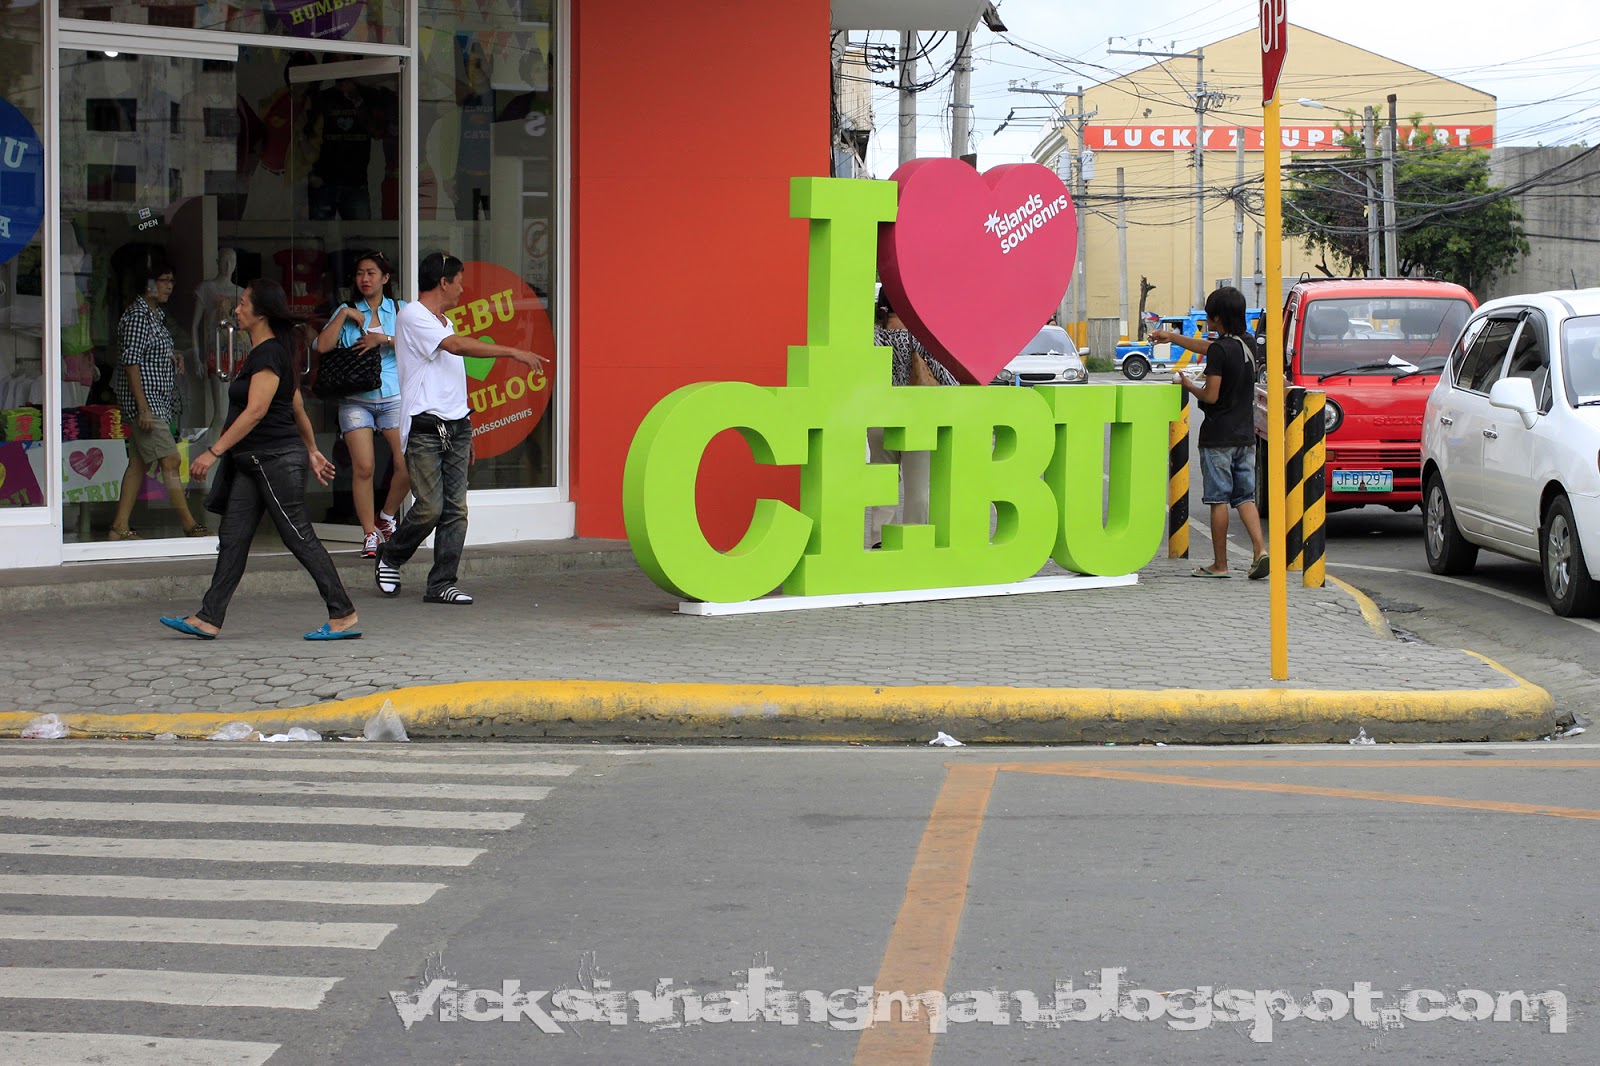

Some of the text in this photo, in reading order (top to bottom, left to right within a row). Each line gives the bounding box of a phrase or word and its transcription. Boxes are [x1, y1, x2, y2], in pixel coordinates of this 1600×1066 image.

[1104, 128, 1214, 147] LUCKY
[138, 218, 159, 231] OPEN
[994, 193, 1044, 239] islands
[1000, 194, 1068, 254] souvenirs
[789, 176, 899, 387] I
[62, 480, 119, 502] EBU
[622, 381, 1183, 603] CEBU
[1336, 473, 1389, 486] JFB 297
